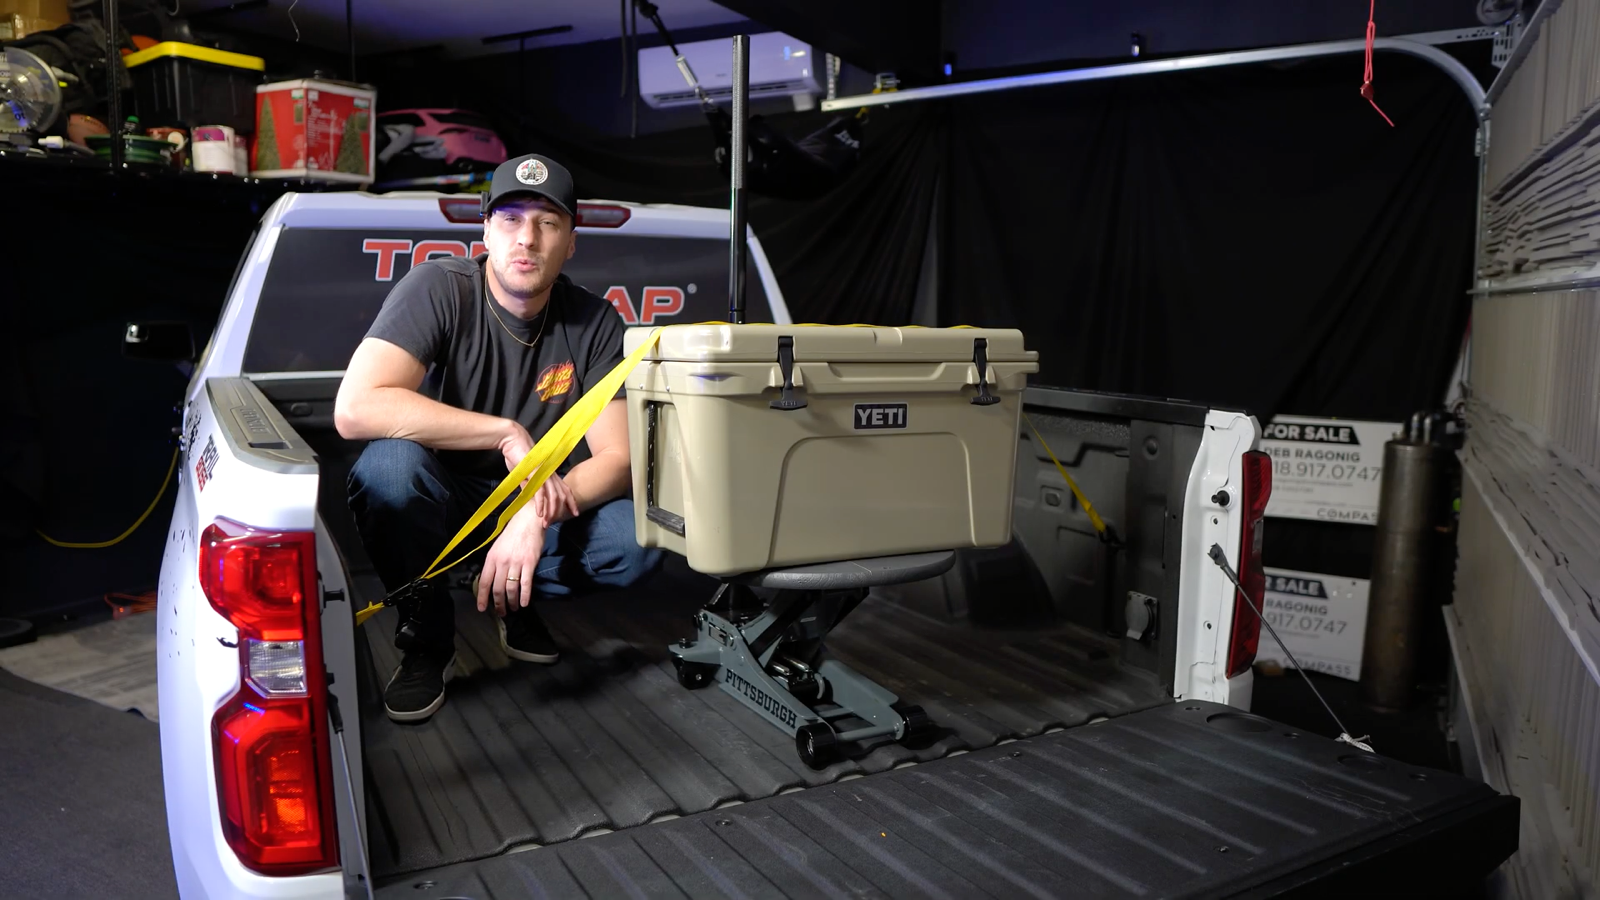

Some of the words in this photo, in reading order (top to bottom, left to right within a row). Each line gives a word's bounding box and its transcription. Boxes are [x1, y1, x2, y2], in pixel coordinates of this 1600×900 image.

[856, 407, 906, 426] YETI
[1263, 423, 1300, 440] FOR
[1304, 426, 1352, 443] SALE
[1295, 449, 1361, 463] RAGONIG
[1273, 461, 1381, 482] 18.917.0747
[1316, 507, 1379, 521] COMPAS
[1276, 577, 1321, 596] SALE
[1266, 612, 1347, 635] 917.0747
[725, 668, 797, 729] PITTSBURGH
